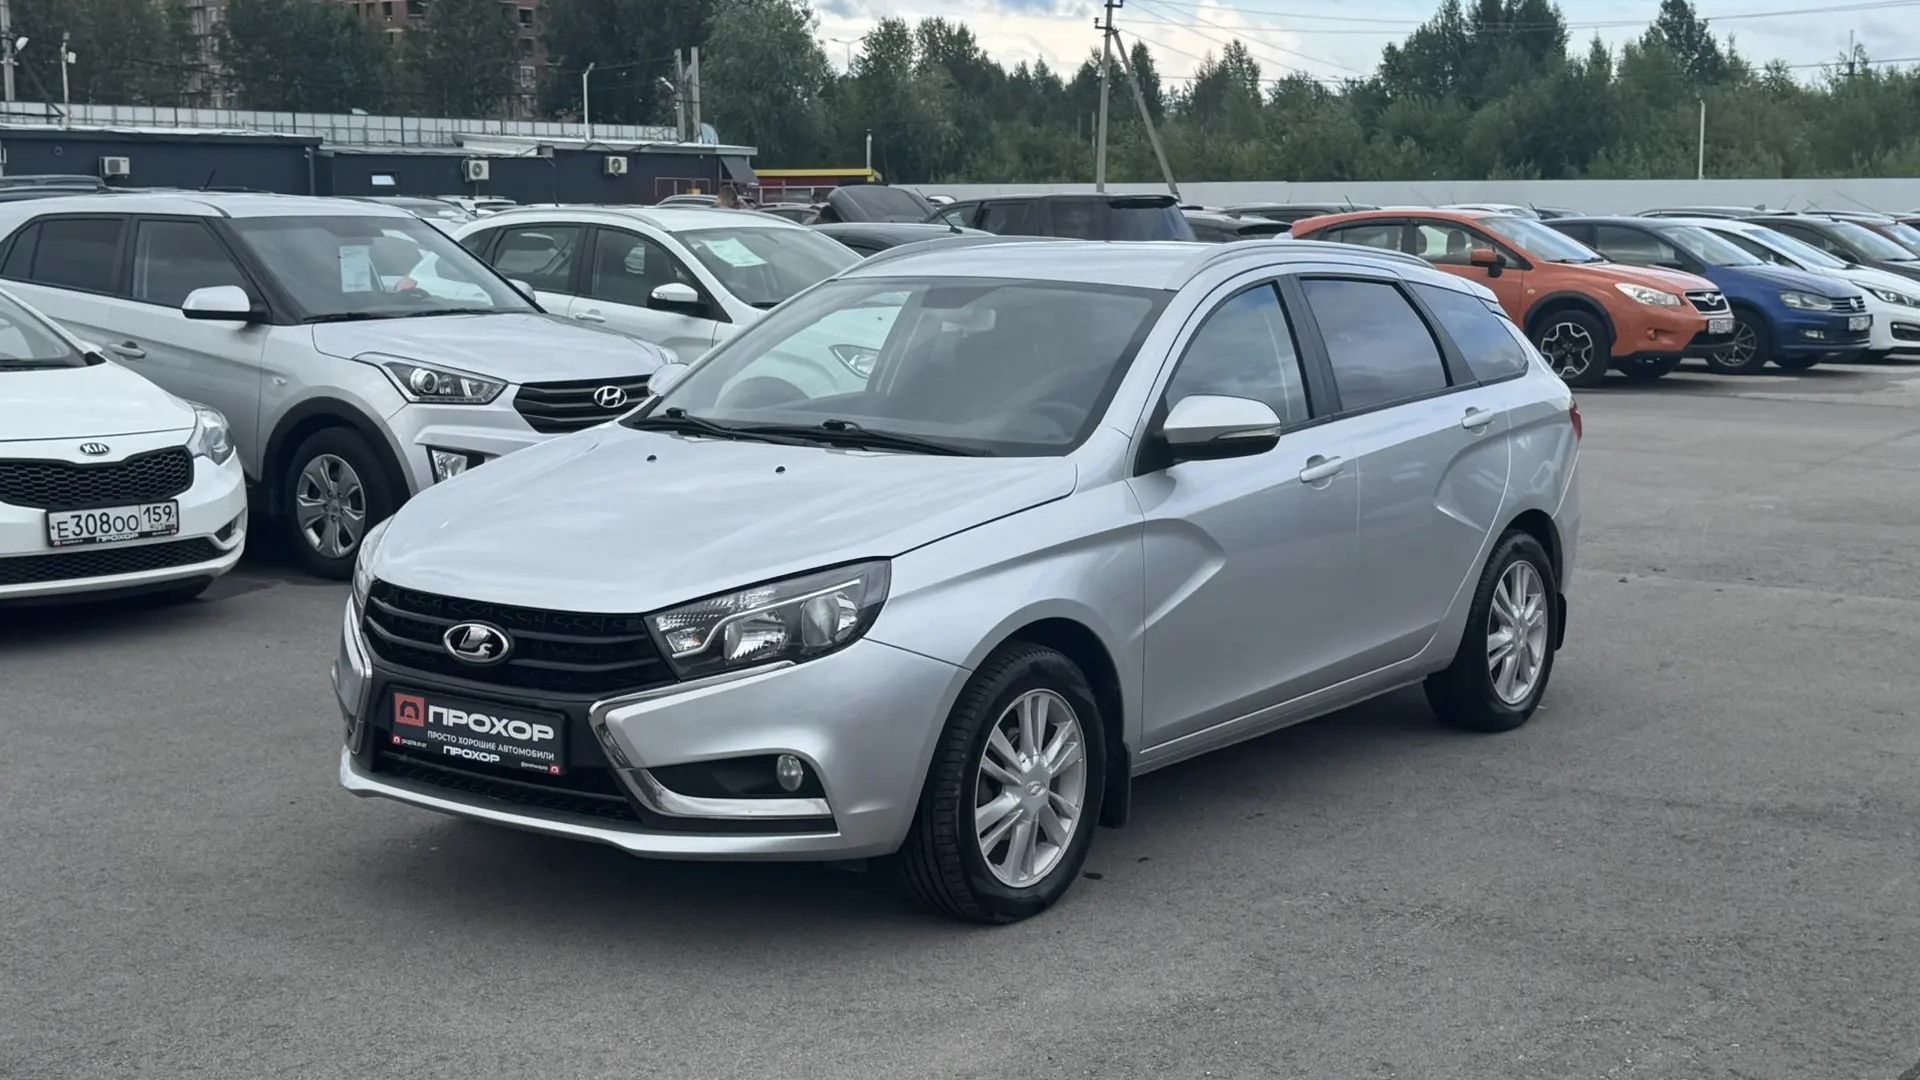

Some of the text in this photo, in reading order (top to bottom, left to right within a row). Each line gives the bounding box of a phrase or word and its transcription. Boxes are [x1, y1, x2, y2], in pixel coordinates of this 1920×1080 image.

[56, 505, 172, 539] Е308ОО 159
[428, 704, 554, 742] ПРОХОР
[427, 730, 555, 761] ПРОСТО ХОРОШИЕ АВТОМОБИЛИ
[443, 745, 500, 763] ПРОХОР
